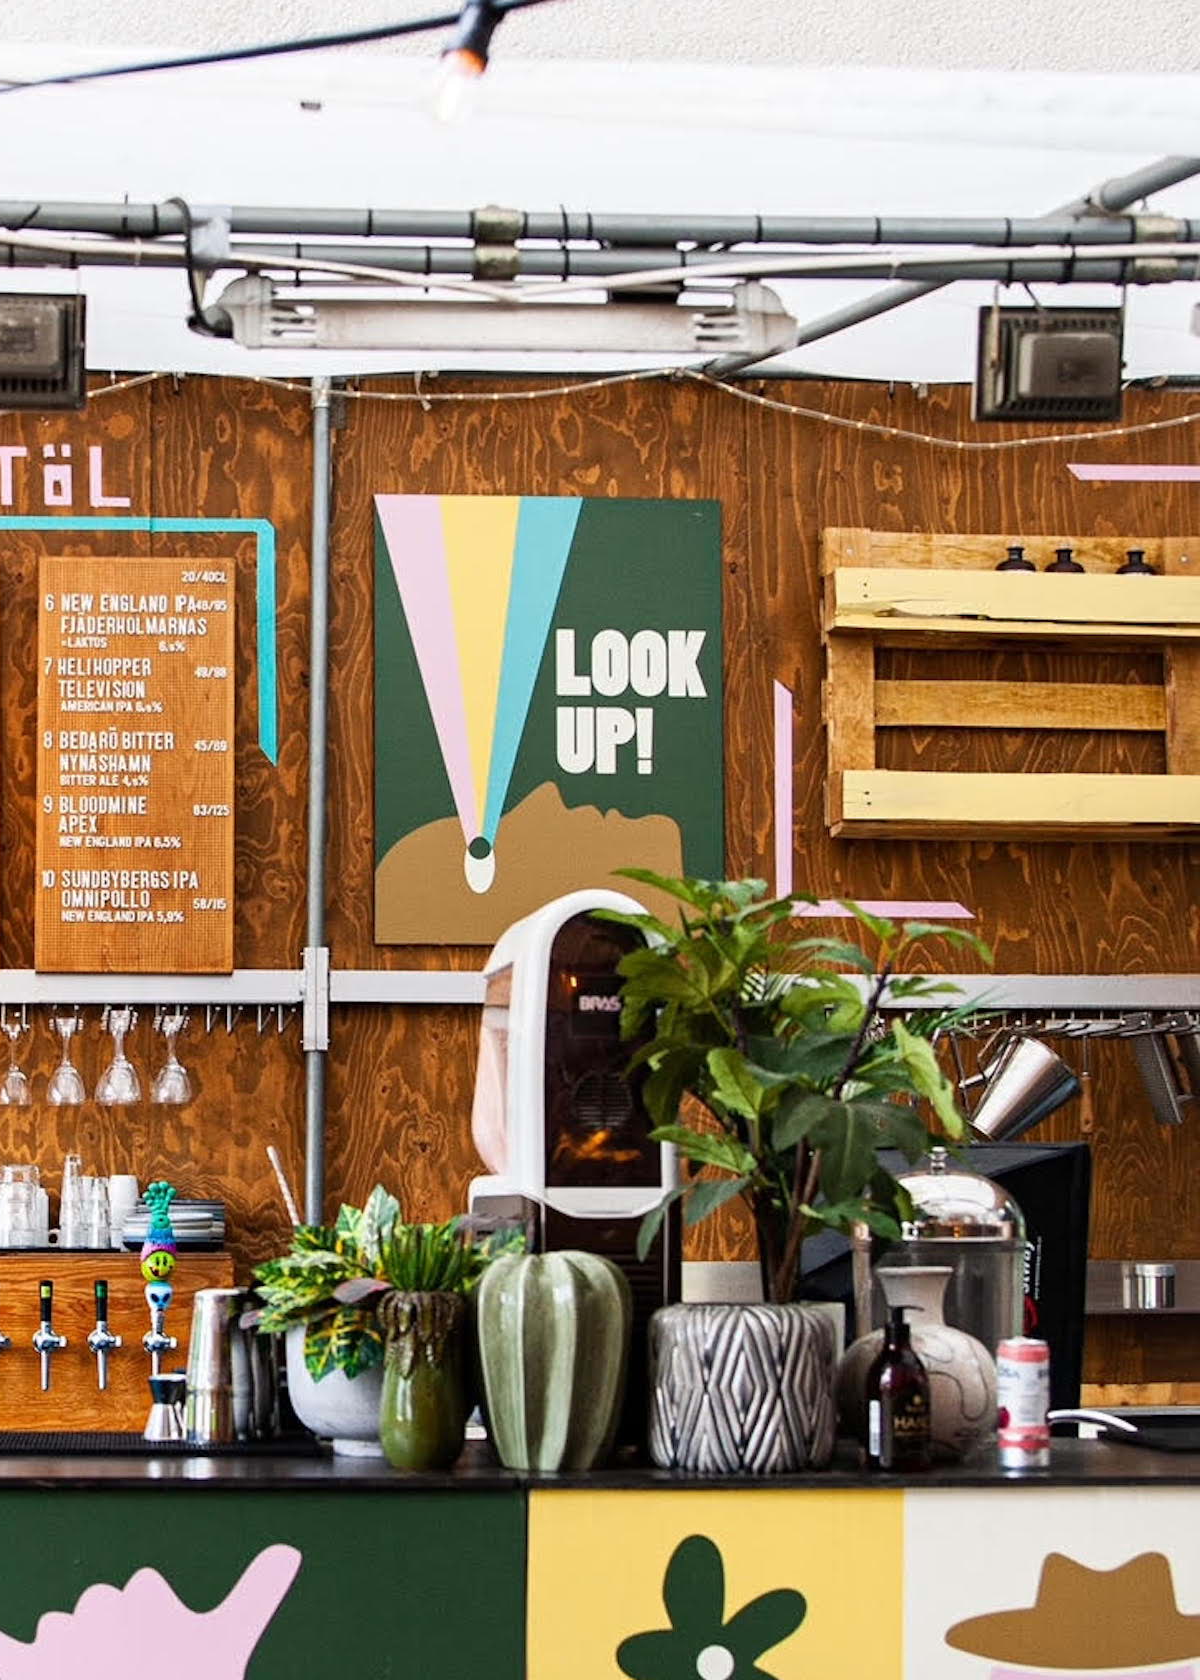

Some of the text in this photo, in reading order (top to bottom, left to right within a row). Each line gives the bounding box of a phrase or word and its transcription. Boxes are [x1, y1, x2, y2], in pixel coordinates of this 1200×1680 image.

[181, 572, 228, 584] 20/40CL
[45, 594, 54, 612] 6
[61, 594, 93, 612] NEW
[101, 596, 168, 612] ENGLAND
[175, 596, 196, 613] IPA
[45, 657, 53, 675] 7
[58, 658, 151, 676] HELIHOPPER
[556, 628, 708, 697] LOOK
[58, 680, 145, 698] TELEVISION
[60, 701, 113, 712] AMERICAN
[116, 702, 134, 713] IPA
[44, 731, 53, 749] 8
[122, 732, 174, 750] BITTER
[556, 706, 654, 775] UP!
[60, 775, 97, 786] BITTER
[99, 775, 119, 786] ALE
[43, 797, 53, 813] 9
[59, 796, 147, 815] BLOODMINE
[58, 815, 97, 833] APEX
[59, 837, 82, 848] NEW
[86, 837, 133, 848] ENGLAND
[135, 837, 152, 848] IPA
[42, 870, 199, 889] 10 SUNDBYBERGS IPA
[61, 890, 150, 908] OMNIPOLLO
[61, 911, 85, 922] NEW
[88, 911, 135, 922] ENGLAND
[137, 911, 154, 922] IPA
